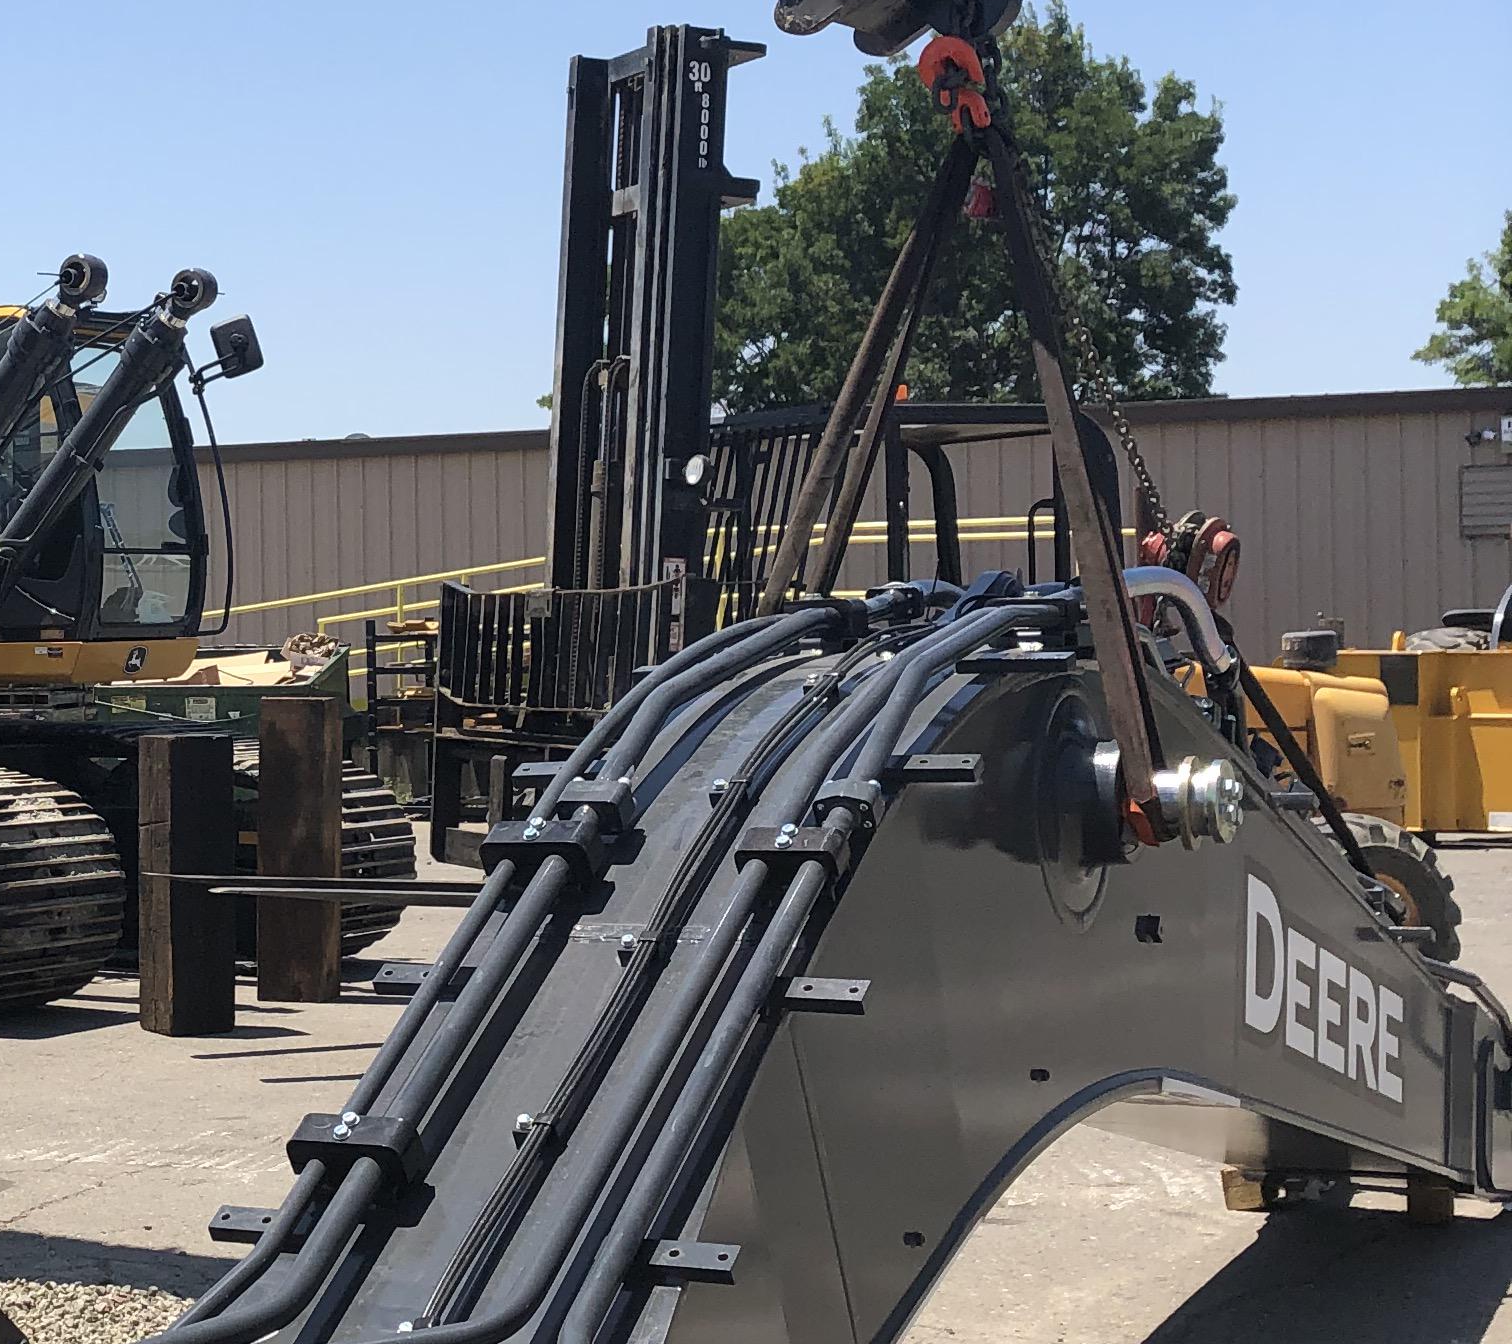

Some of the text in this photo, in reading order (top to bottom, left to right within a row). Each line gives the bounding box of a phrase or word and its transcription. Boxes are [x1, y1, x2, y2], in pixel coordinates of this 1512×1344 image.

[689, 60, 711, 82] 30
[699, 93, 710, 156] 8000
[1245, 873, 1404, 1104] DEERE
